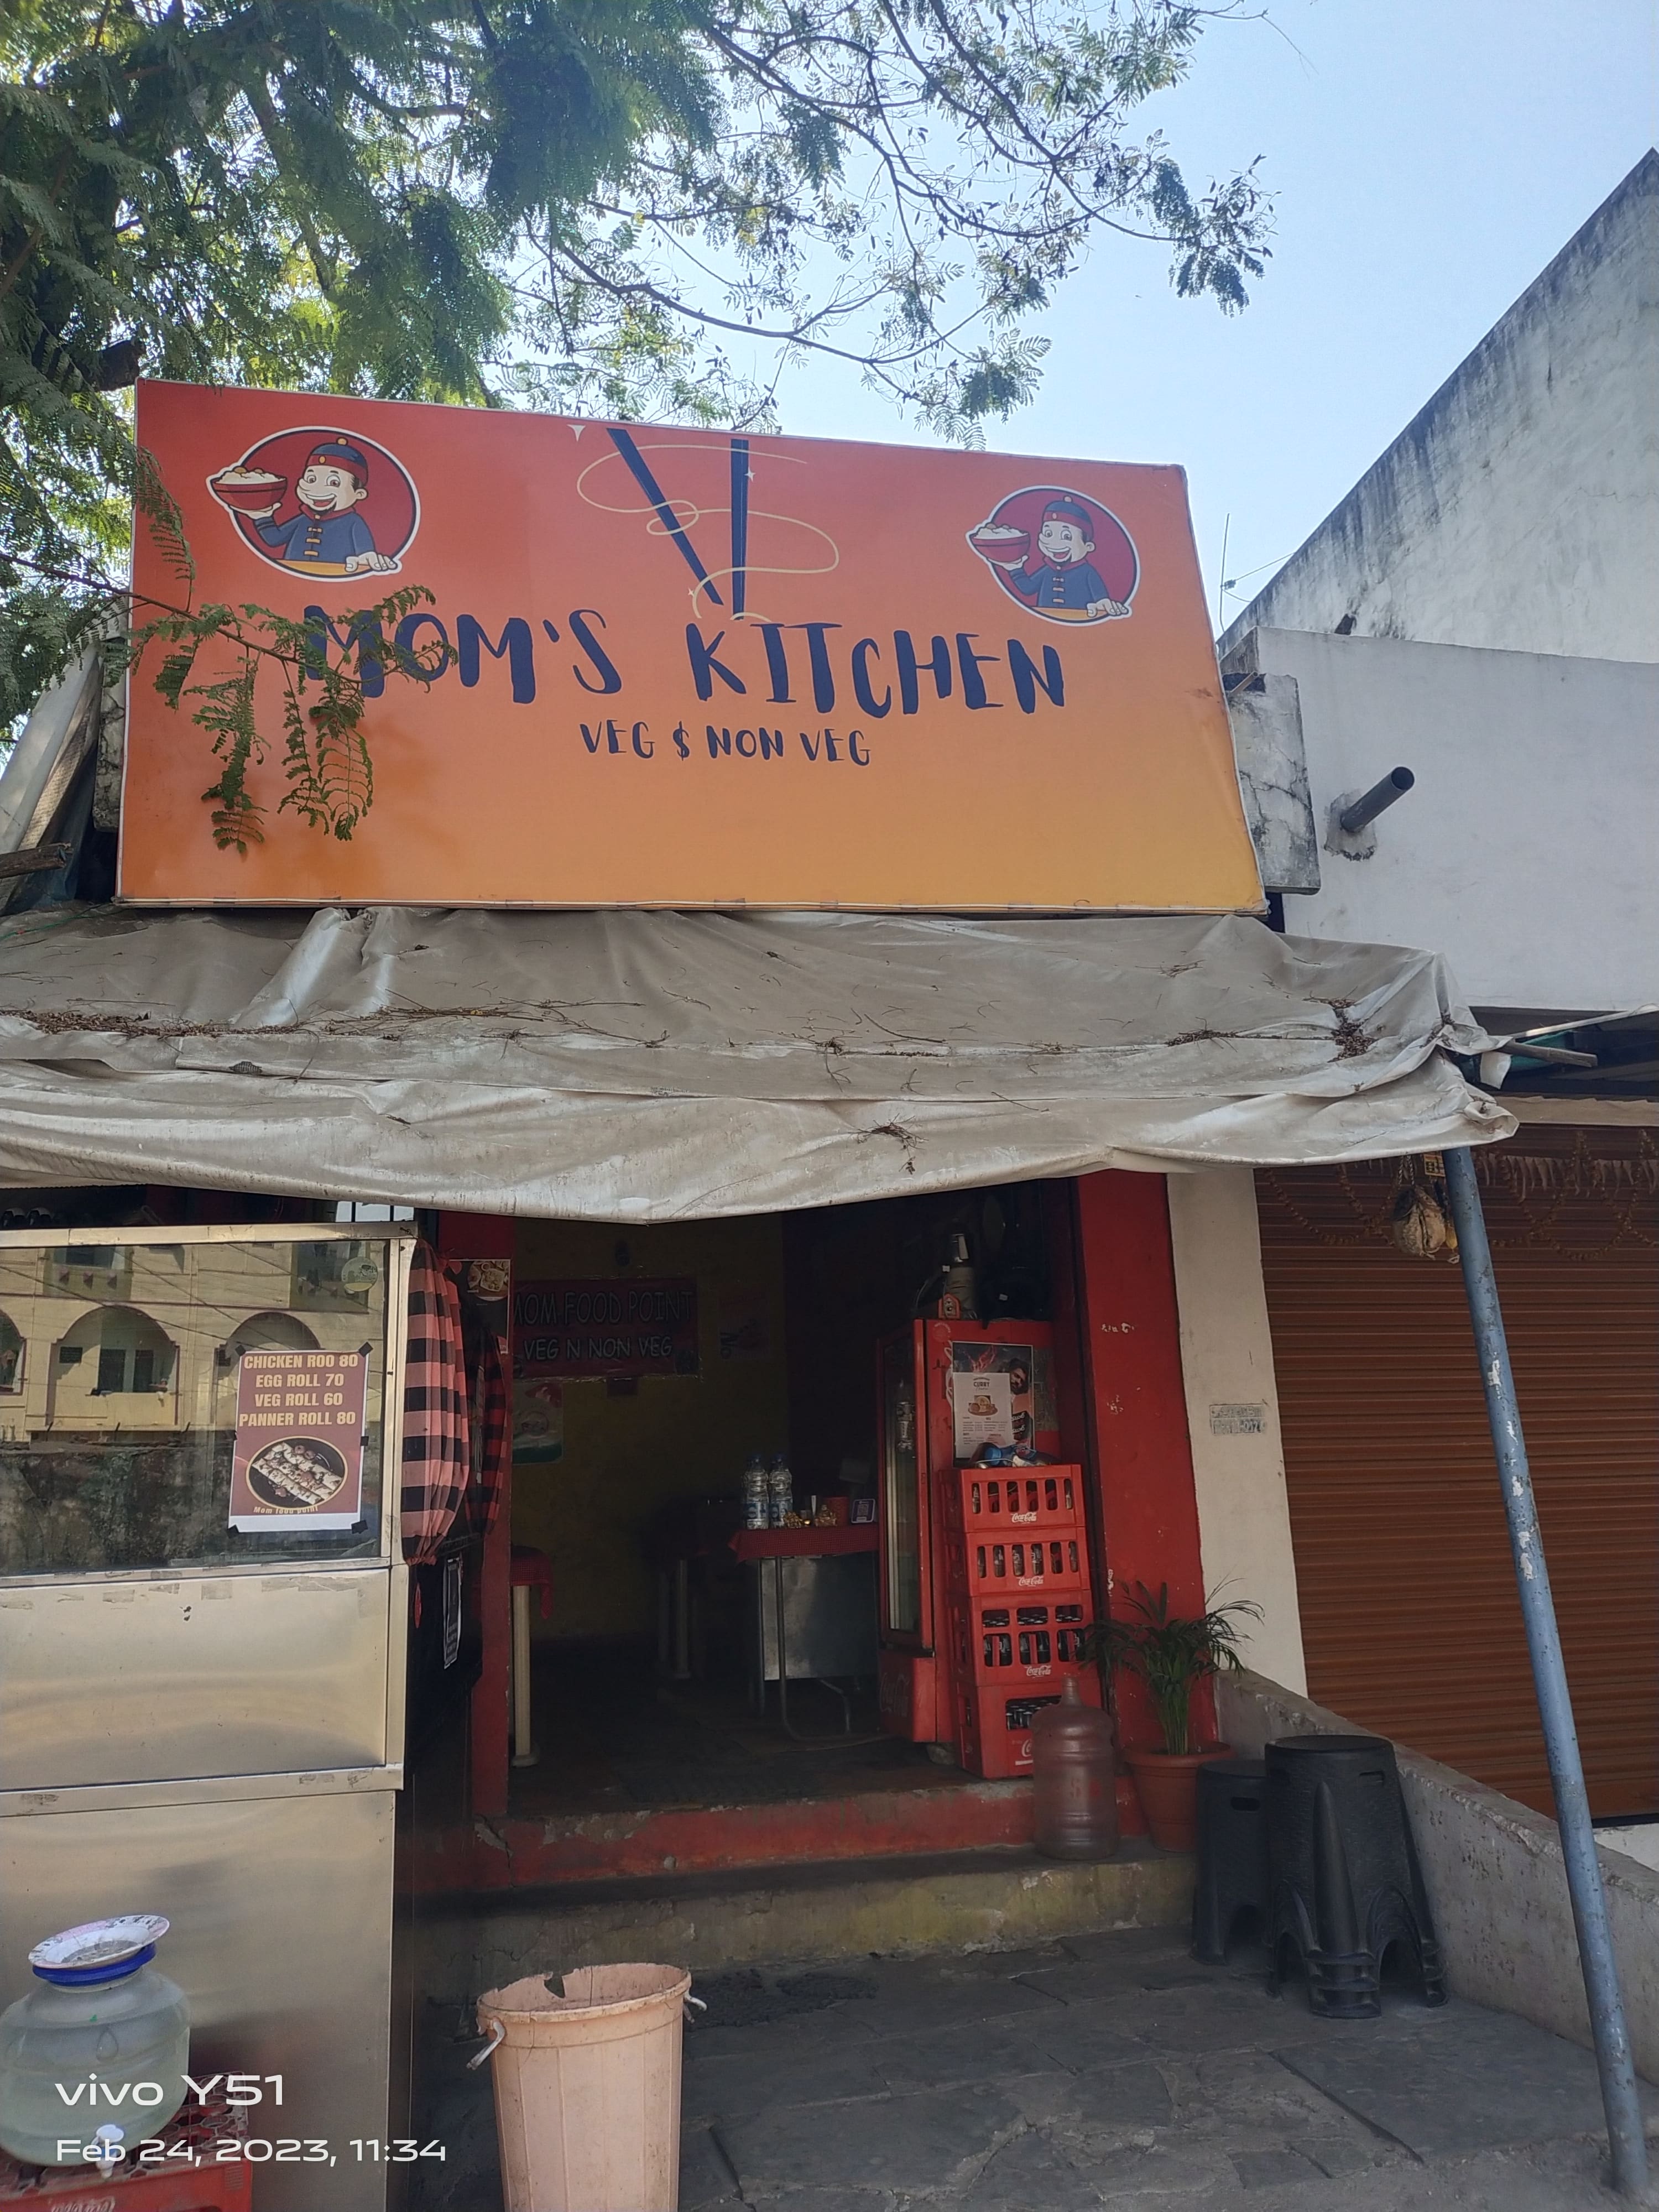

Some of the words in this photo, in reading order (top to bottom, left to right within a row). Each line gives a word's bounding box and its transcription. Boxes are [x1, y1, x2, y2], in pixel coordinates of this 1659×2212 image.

[304, 604, 622, 704] MOM'S
[686, 622, 1065, 719] KITCHEN
[579, 719, 656, 759] VEG
[672, 721, 691, 761] $
[706, 724, 784, 760] NON
[799, 728, 871, 766] VEG
[564, 1291, 622, 1326] FOOD
[628, 1290, 693, 1323] POINT
[523, 1338, 559, 1360] VEG
[566, 1338, 580, 1359] N
[588, 1337, 630, 1358] NON
[638, 1334, 673, 1357] VEG
[244, 1355, 302, 1369] CHICKEN
[338, 1354, 358, 1368] 80
[255, 1374, 283, 1388] EGG
[286, 1374, 321, 1387] ROLL
[325, 1373, 345, 1386] 70
[254, 1393, 281, 1407] VEG
[285, 1392, 320, 1406] ROLL
[324, 1392, 343, 1406] 60
[239, 1412, 294, 1427] PANNER
[298, 1412, 332, 1426] ROLL
[336, 1411, 356, 1425] 80
